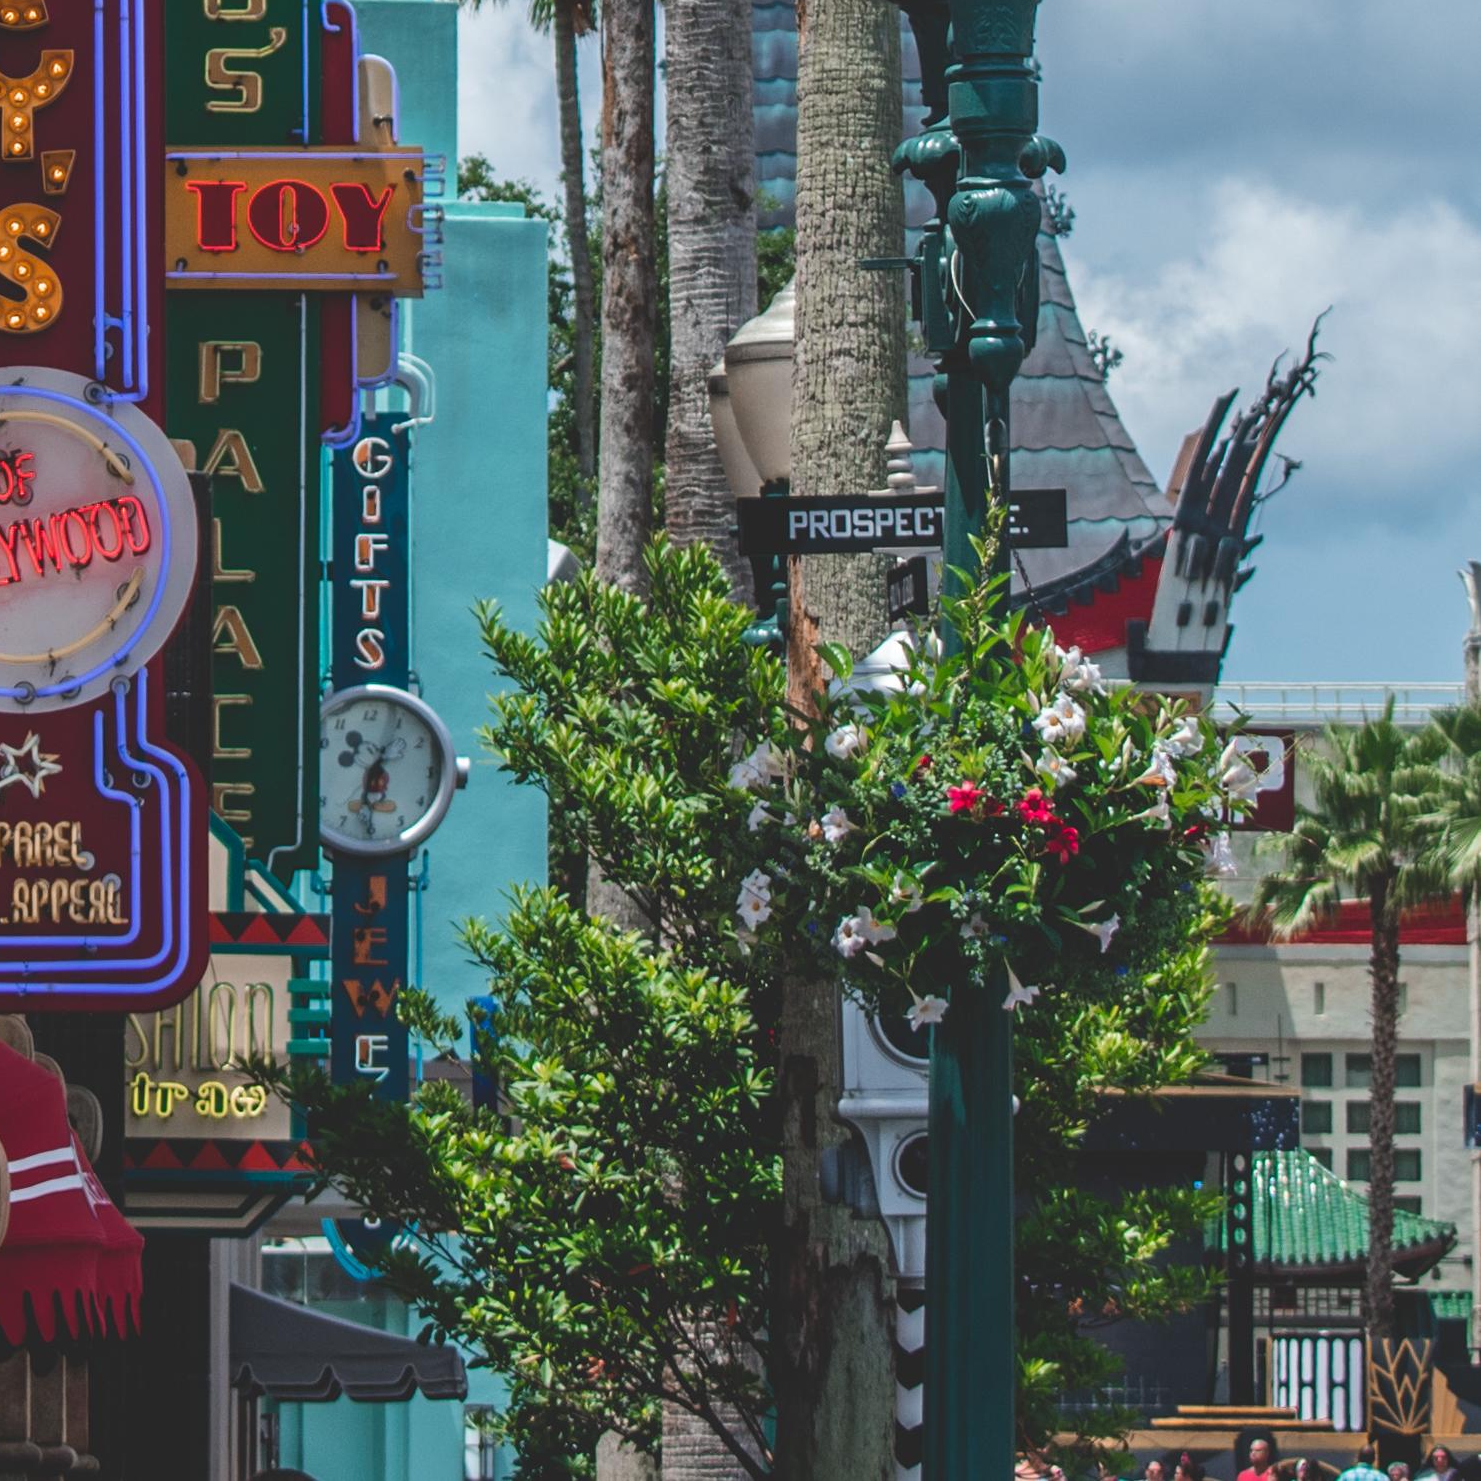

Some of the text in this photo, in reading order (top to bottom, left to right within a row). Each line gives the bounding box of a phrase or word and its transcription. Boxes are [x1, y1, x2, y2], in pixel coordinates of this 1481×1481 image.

[186, 179, 397, 252] TOY
[198, 340, 265, 850] PALACE
[349, 437, 393, 670] GIFTS
[12, 878, 129, 924] APPEAL
